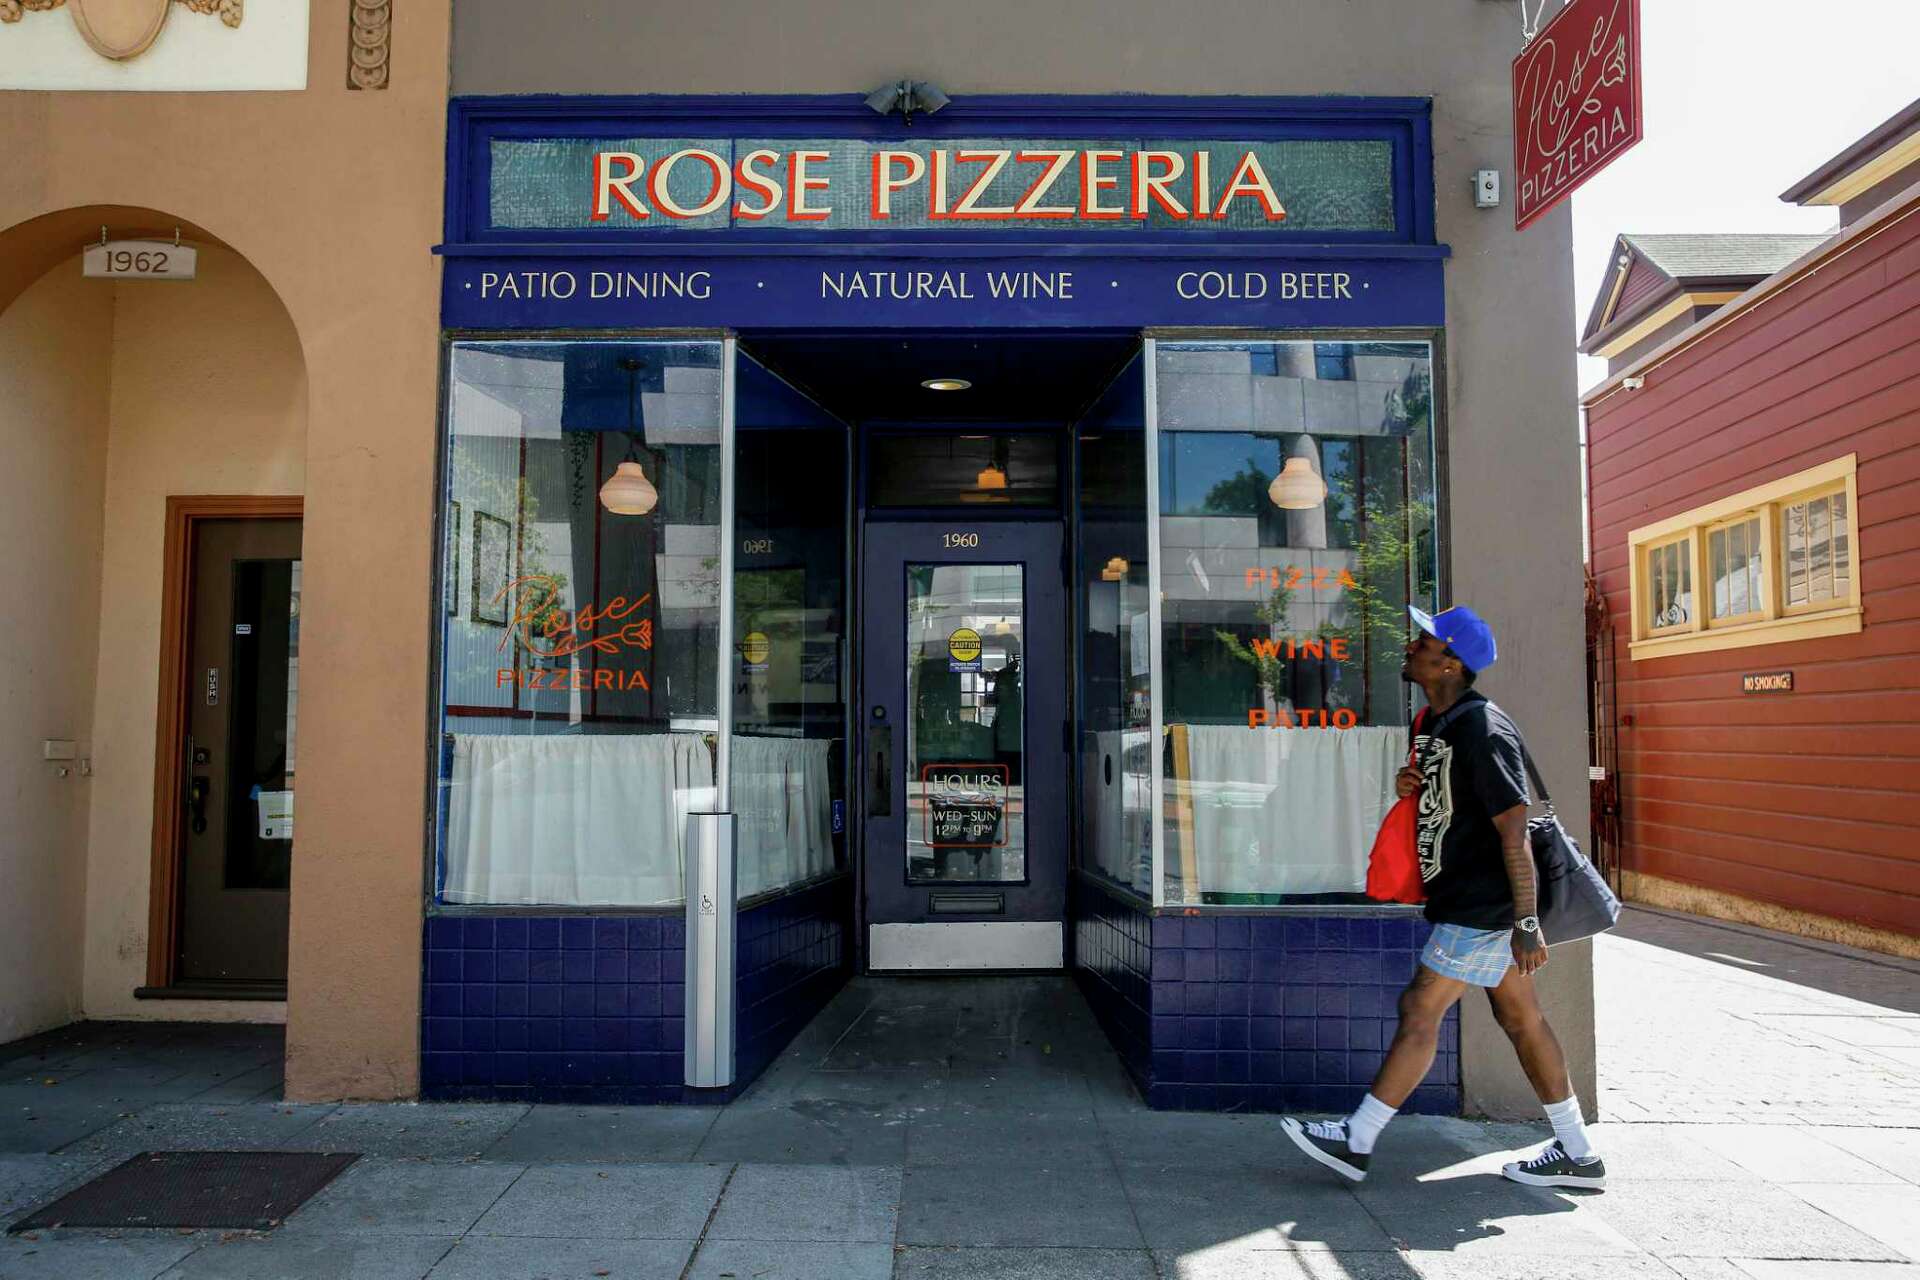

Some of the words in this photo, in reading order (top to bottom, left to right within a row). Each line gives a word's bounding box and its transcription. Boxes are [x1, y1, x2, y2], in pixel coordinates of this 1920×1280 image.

[1518, 0, 1621, 176] Rose
[1521, 106, 1626, 211] PIZZERIA
[592, 149, 832, 220] ROSE
[871, 150, 1285, 220] PIZZERIA
[105, 251, 169, 273] 1962
[480, 271, 576, 298] PATIO
[590, 271, 711, 299] DINING
[821, 271, 974, 298] NATURAL
[987, 271, 1073, 299] WINE
[1176, 271, 1267, 299] COLD
[1281, 272, 1352, 299] BEER
[943, 533, 978, 547] 1960
[1246, 567, 1356, 590] PIZZA
[492, 576, 650, 655] Rose
[950, 641, 980, 649] CAUTION
[1252, 638, 1351, 661] WINE
[496, 669, 650, 691] PIZZERIA
[1744, 676, 1754, 690] NO
[1248, 708, 1357, 730] PATIO
[933, 774, 1001, 792] HOURS
